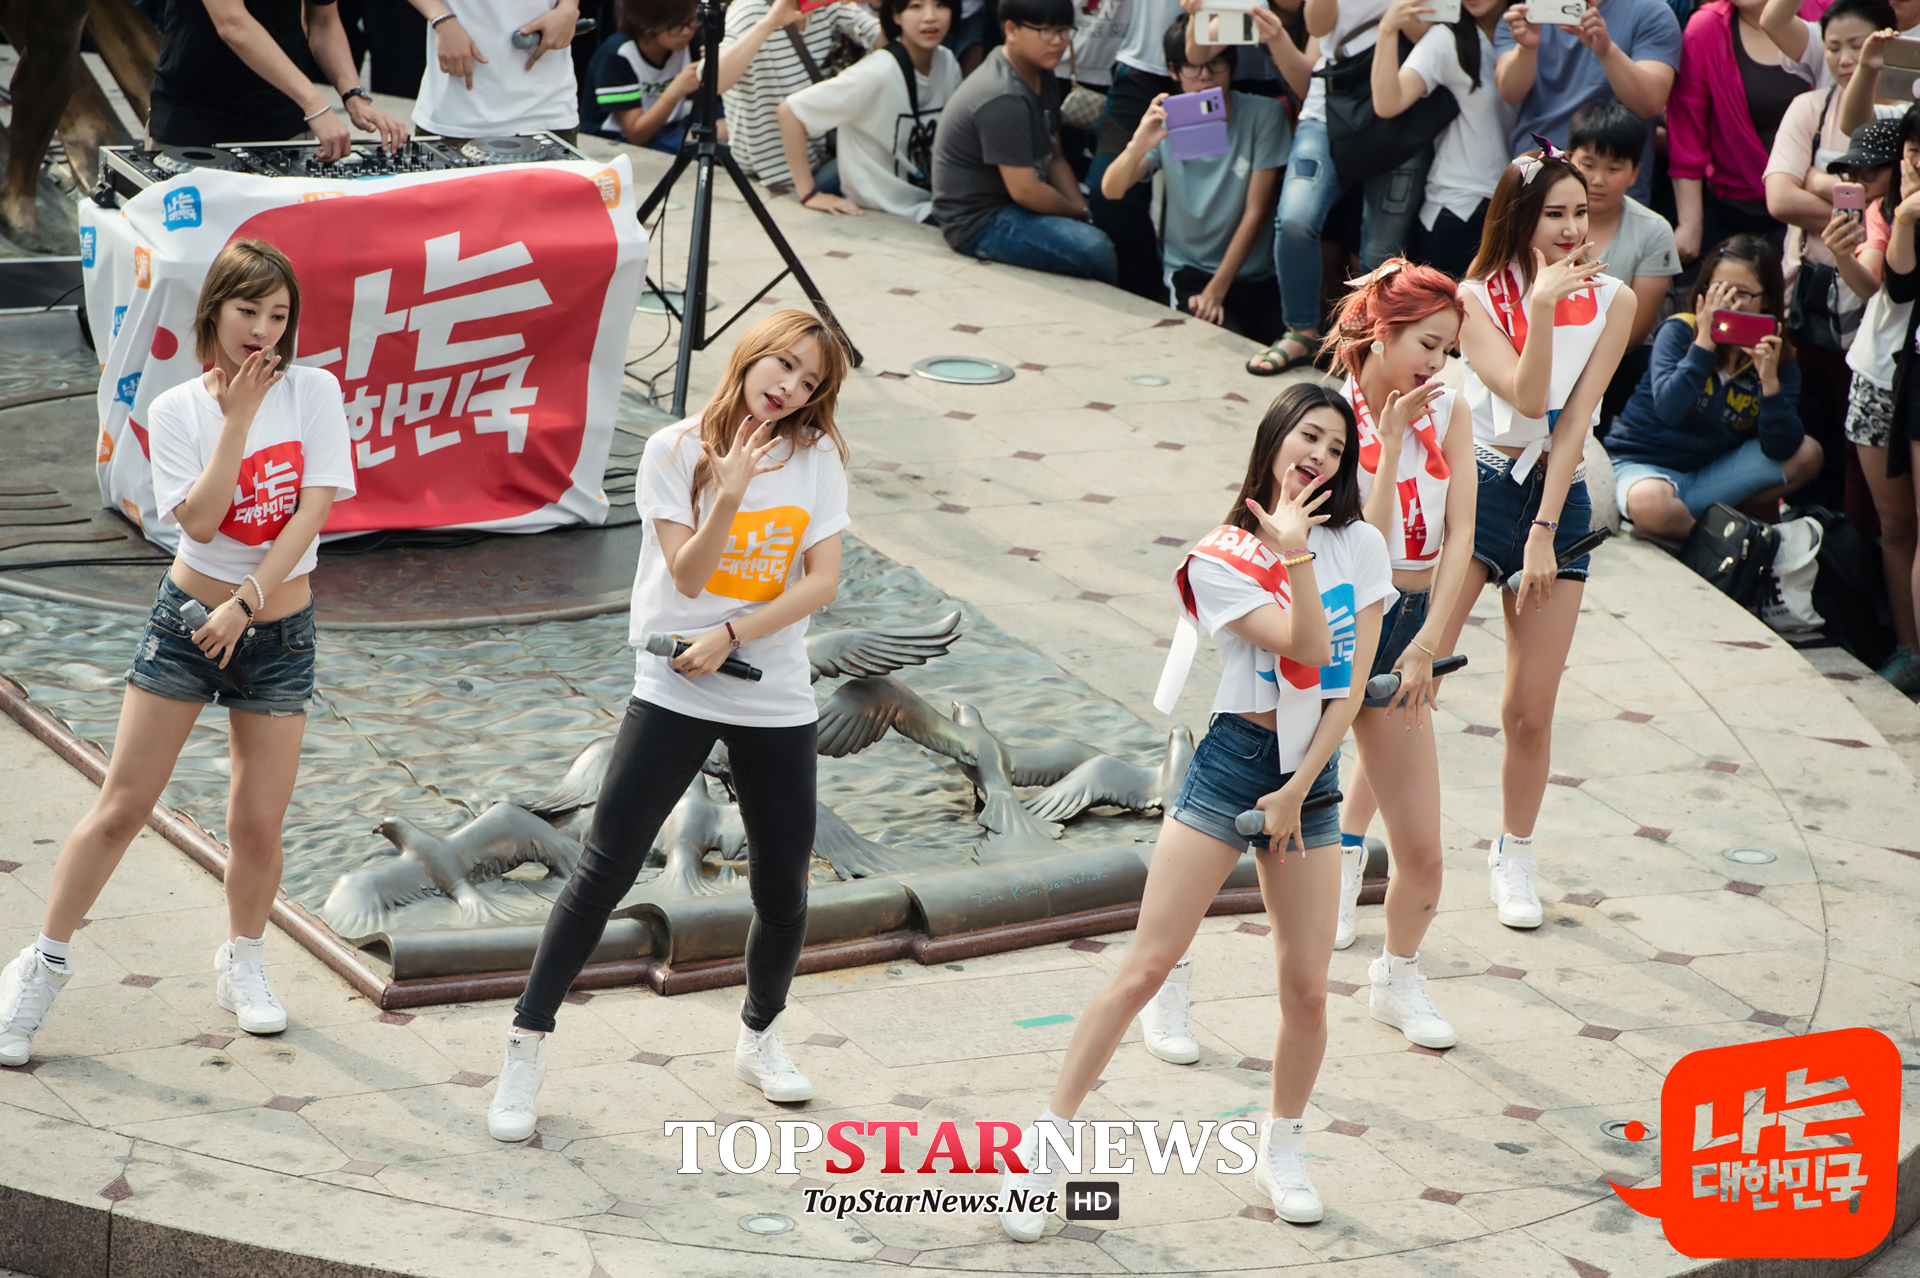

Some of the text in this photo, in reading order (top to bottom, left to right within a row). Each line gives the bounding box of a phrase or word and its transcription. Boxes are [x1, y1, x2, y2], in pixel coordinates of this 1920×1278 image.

[344, 355, 539, 469] 한민국
[233, 460, 299, 506] 나는
[722, 521, 794, 558] 나는
[717, 557, 787, 584] 대한민국
